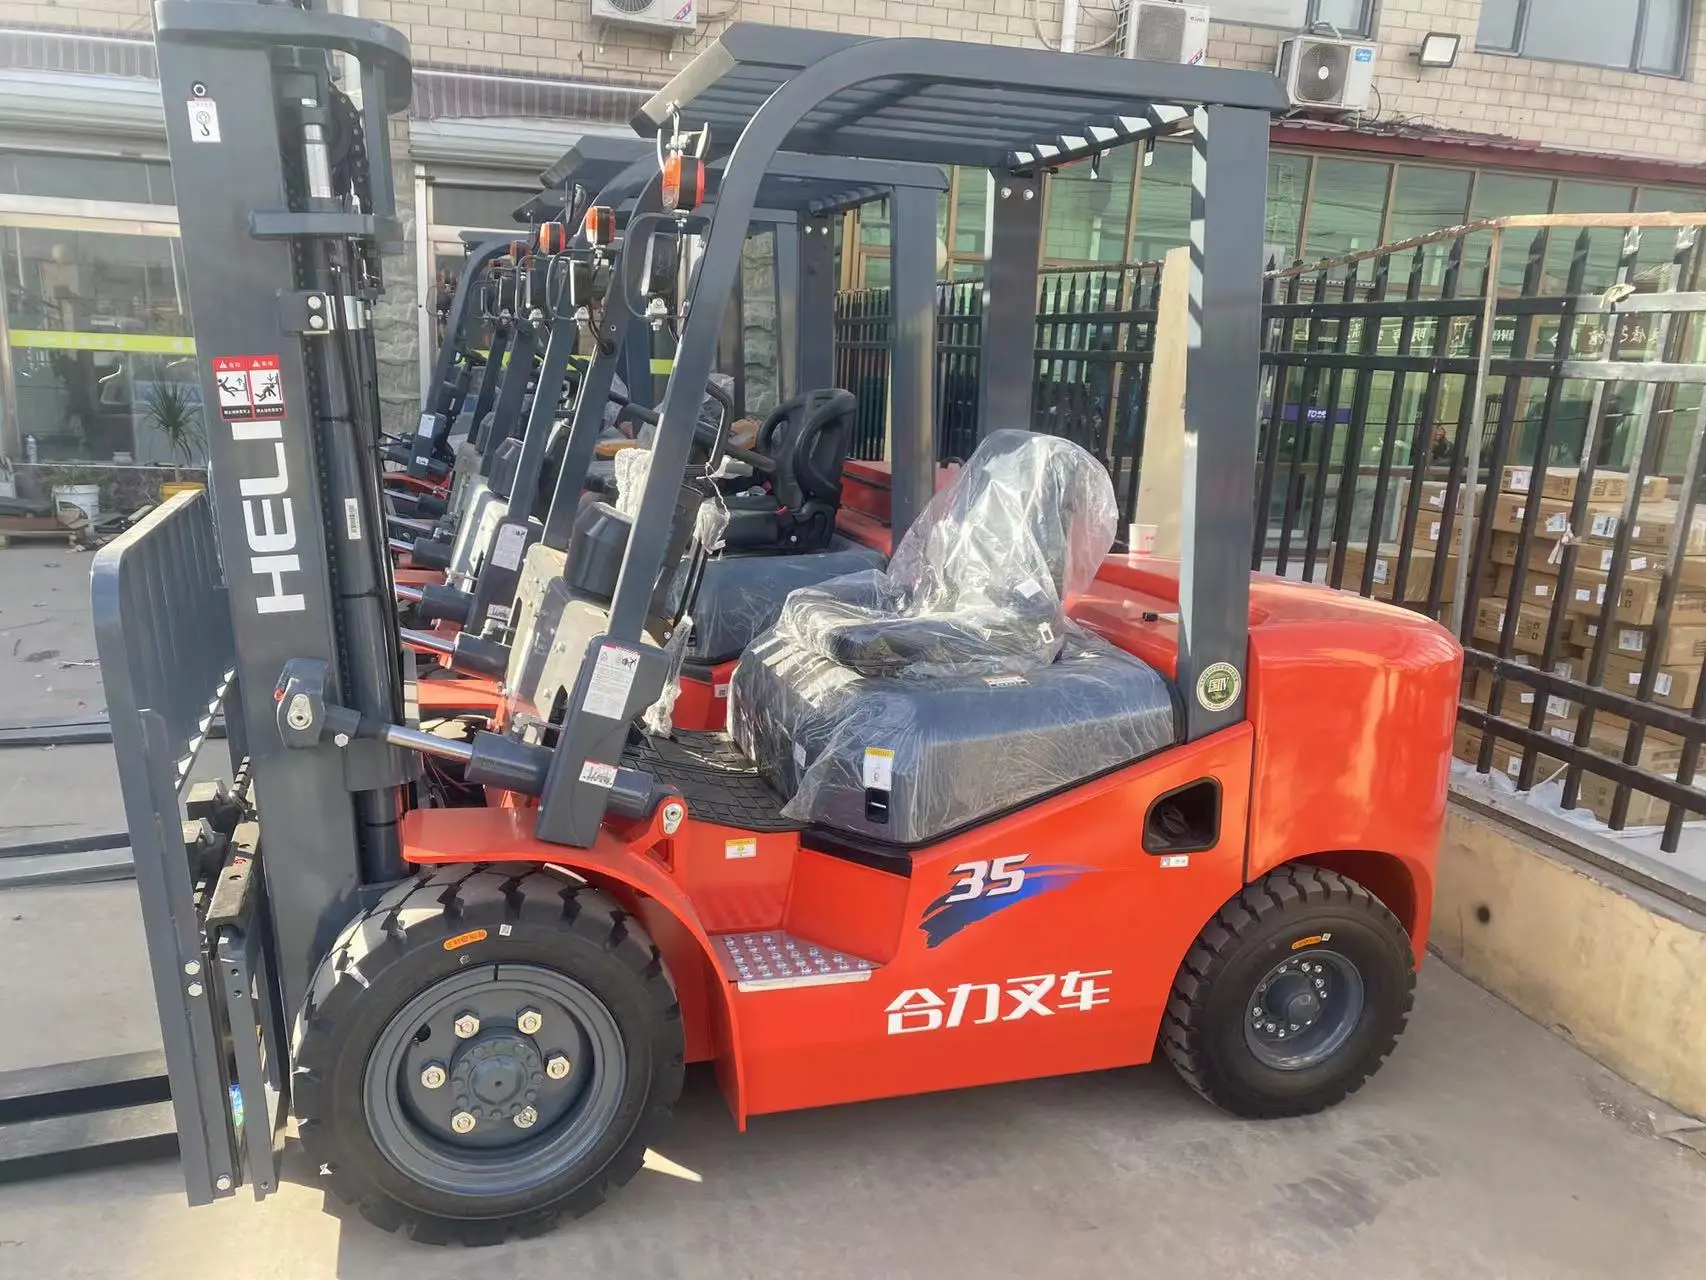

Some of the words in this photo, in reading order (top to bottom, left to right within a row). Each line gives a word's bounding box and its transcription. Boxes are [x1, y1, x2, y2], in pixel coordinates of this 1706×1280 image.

[231, 421, 306, 613] HELI
[945, 853, 1031, 904] 35
[884, 969, 1113, 1035] 合力叉车
